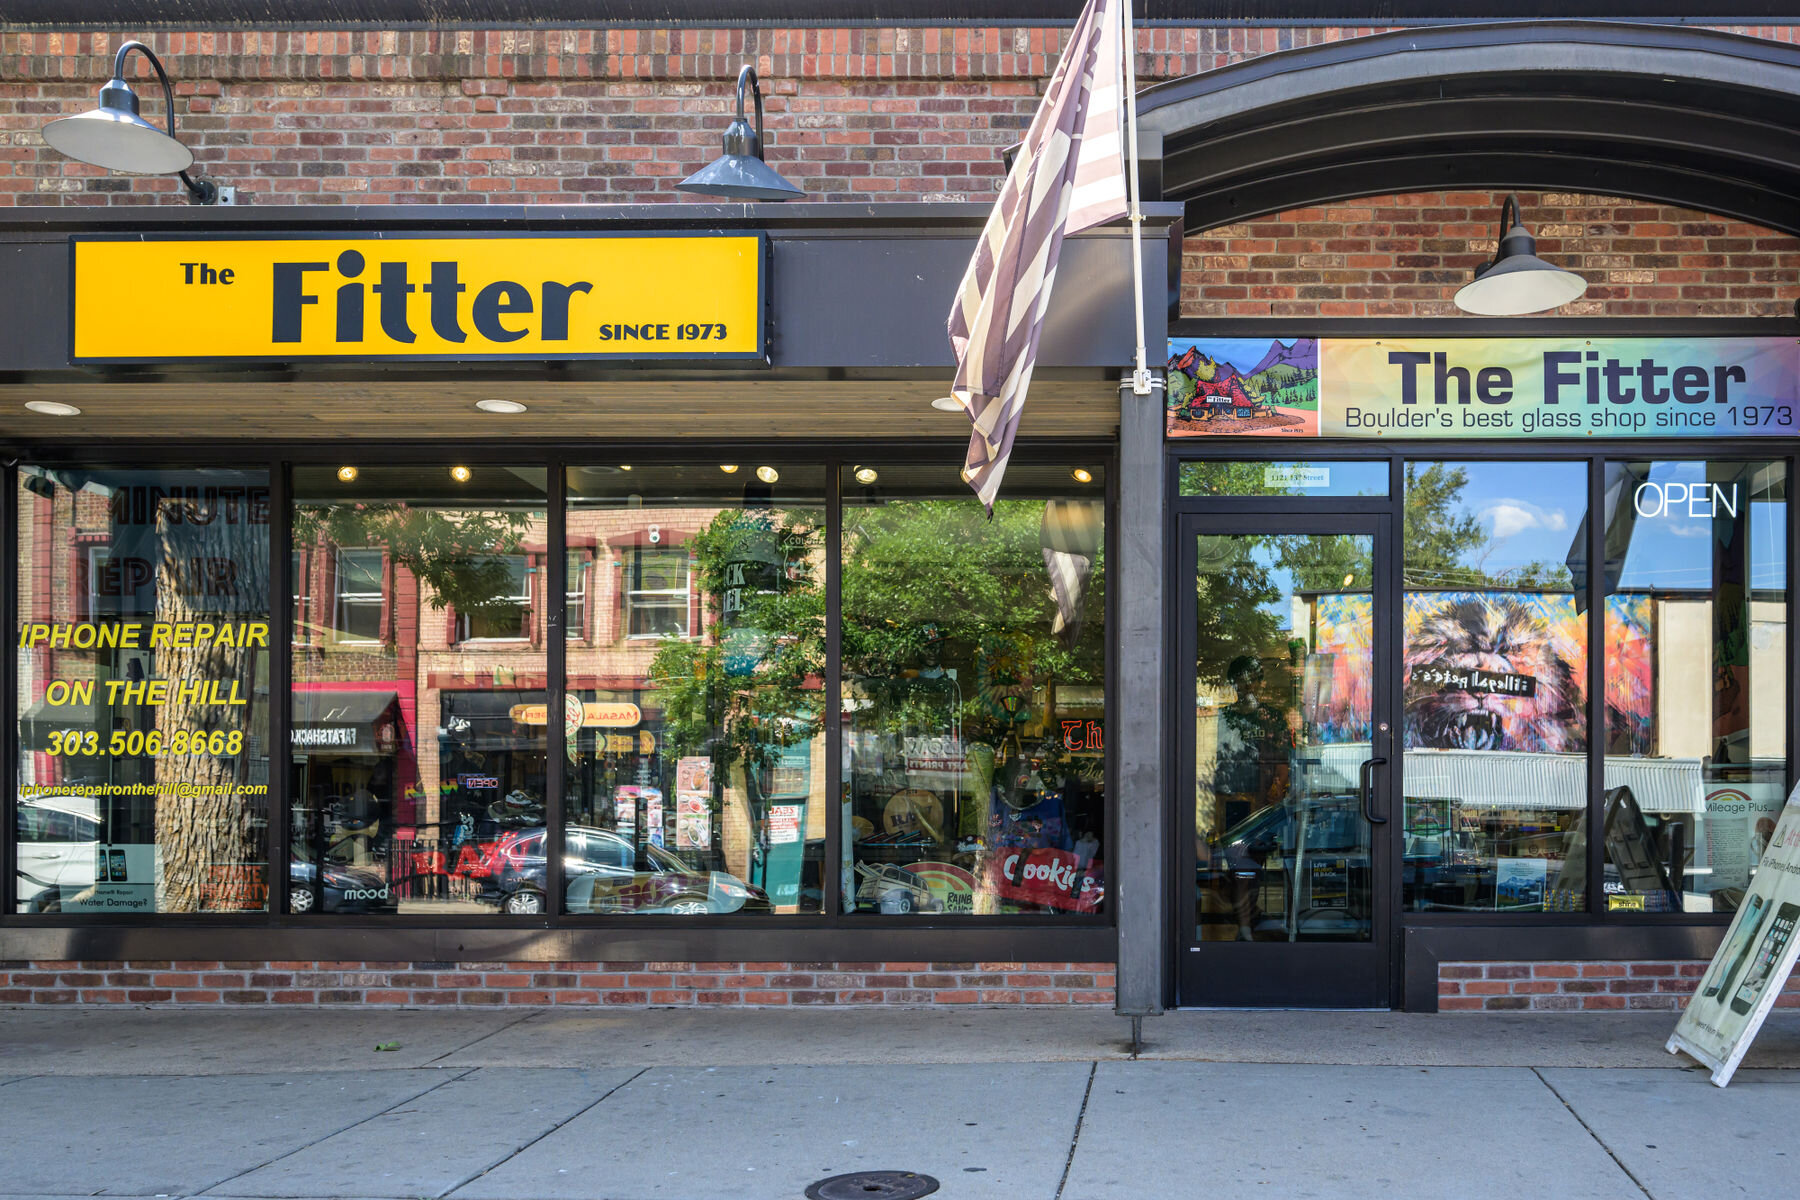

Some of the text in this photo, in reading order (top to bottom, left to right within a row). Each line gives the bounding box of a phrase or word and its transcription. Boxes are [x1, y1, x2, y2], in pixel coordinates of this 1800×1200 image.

[179, 249, 594, 344] The Fitter
[599, 323, 728, 341] SINCE 1973
[1388, 351, 1747, 405] The Fitter
[1345, 405, 1793, 433] Boulder's best glass shop since 1973
[1634, 482, 1738, 519] OPEN
[19, 622, 269, 649] IPHONE REPAIR
[46, 680, 247, 706] ON THE HILL
[45, 729, 243, 756] 303.506.8668
[19, 783, 268, 798] iphonerepaironthehill@gmail.com
[1705, 802, 1746, 814] Mileage
[79, 898, 148, 909] Water Damage?
[344, 883, 390, 900] mood
